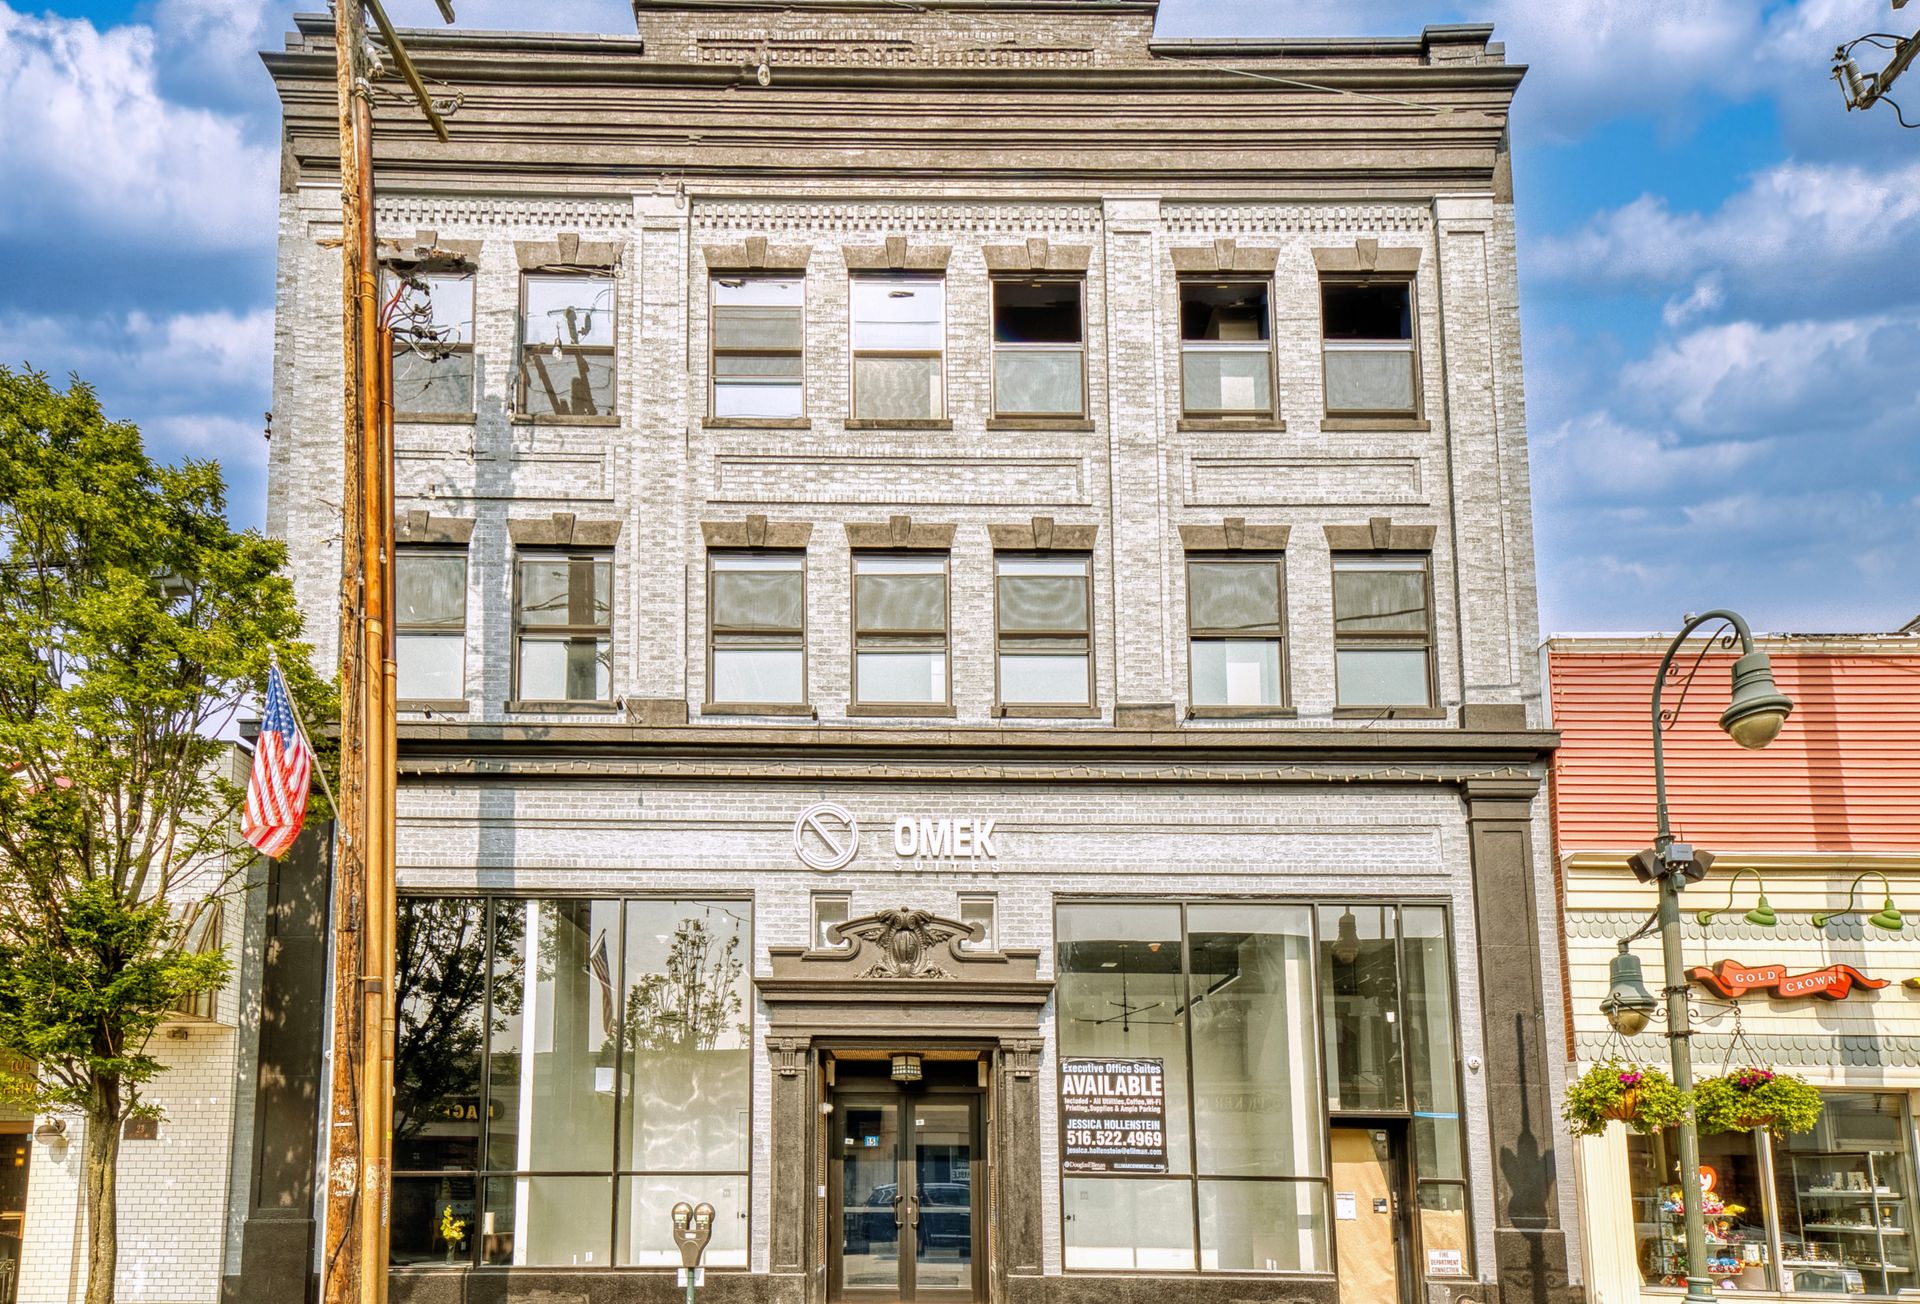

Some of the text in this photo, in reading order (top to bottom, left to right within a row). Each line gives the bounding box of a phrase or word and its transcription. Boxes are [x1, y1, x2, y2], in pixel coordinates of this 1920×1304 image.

[894, 816, 996, 857] OMEK
[894, 861, 1000, 873] SUITES
[1735, 970, 1776, 983] GOLD
[1786, 975, 1836, 992] CROWN
[1062, 1063, 1160, 1074] Executive Office Suites
[1062, 1075, 1162, 1096] AVAILABLE
[1139, 1106, 1160, 1114] Parking
[1067, 1119, 1160, 1130] JESSICA HOLLENSTEIN
[1067, 1130, 1162, 1146] 516.522.4969
